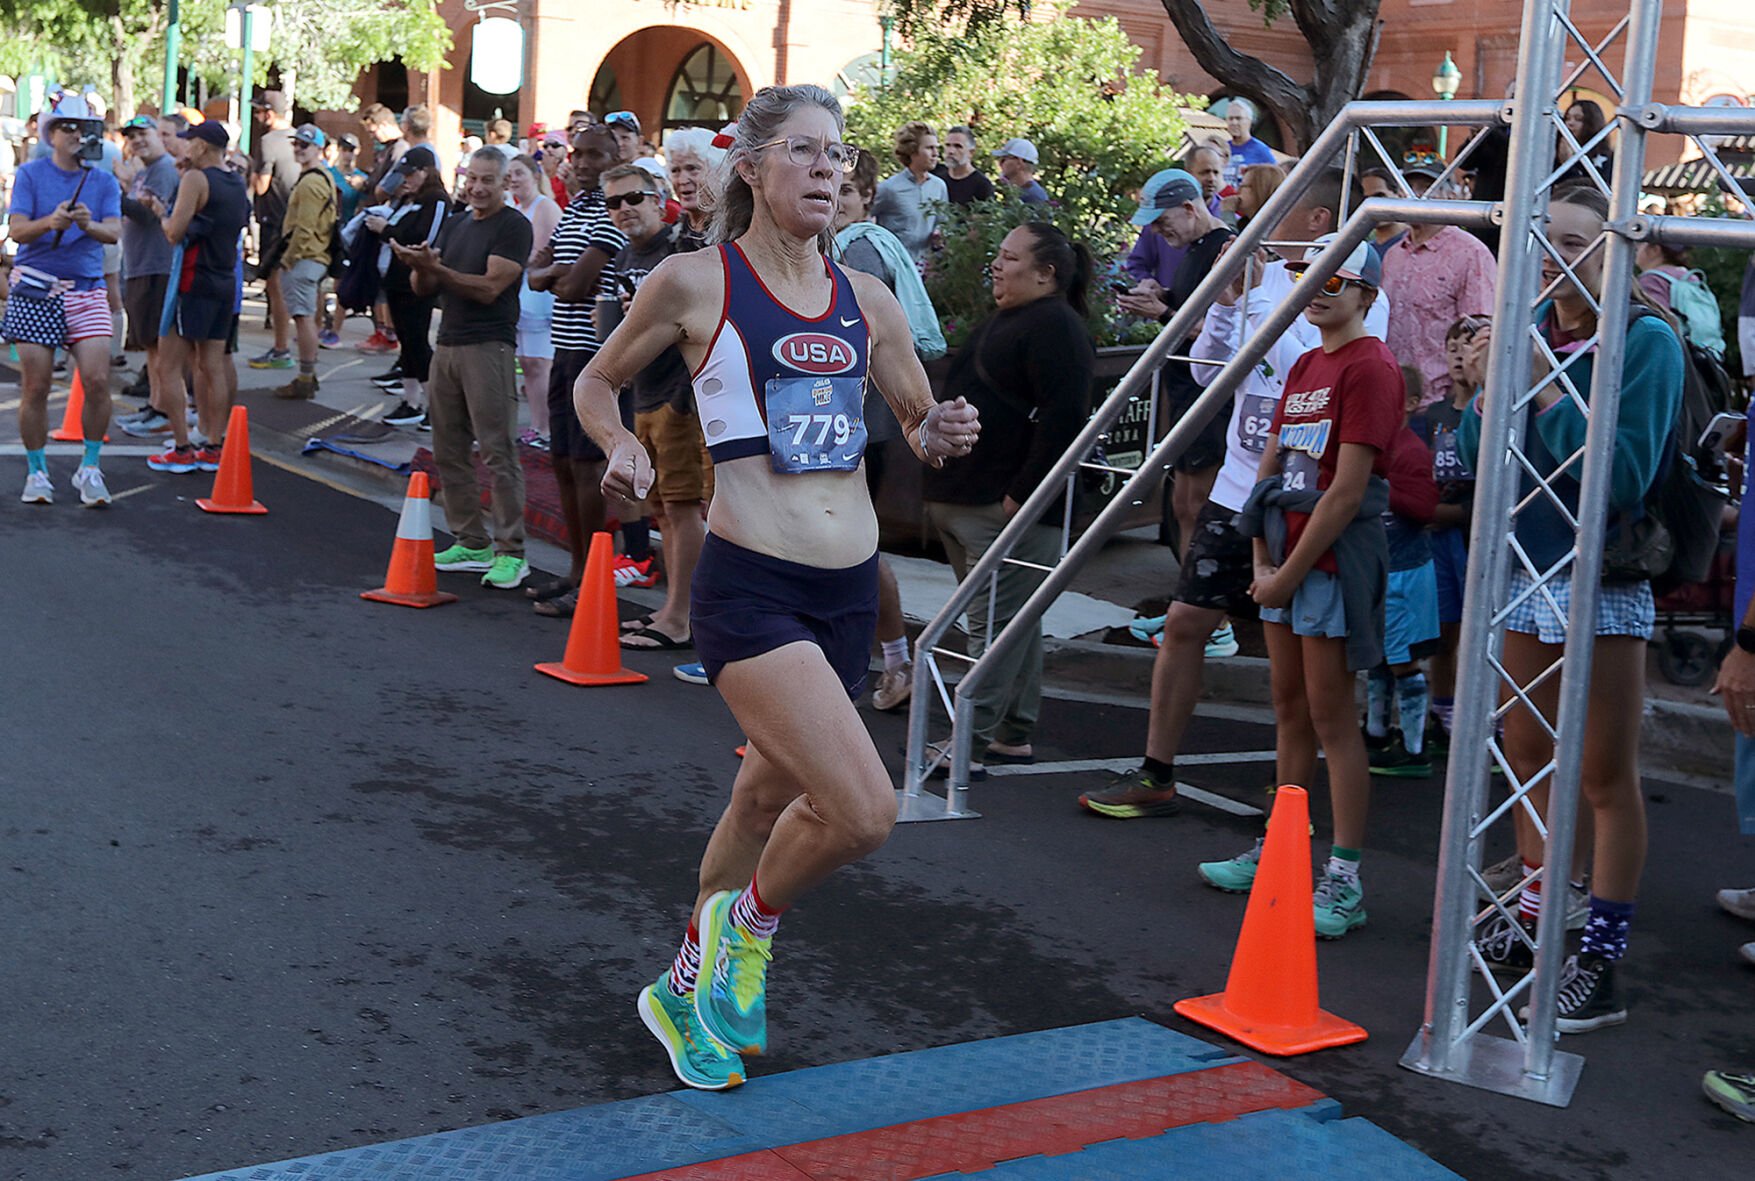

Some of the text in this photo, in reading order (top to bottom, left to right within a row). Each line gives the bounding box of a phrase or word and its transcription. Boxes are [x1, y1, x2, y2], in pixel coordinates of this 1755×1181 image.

[789, 341, 848, 365] USA
[788, 414, 850, 446] 779
[1435, 450, 1463, 468] 85
